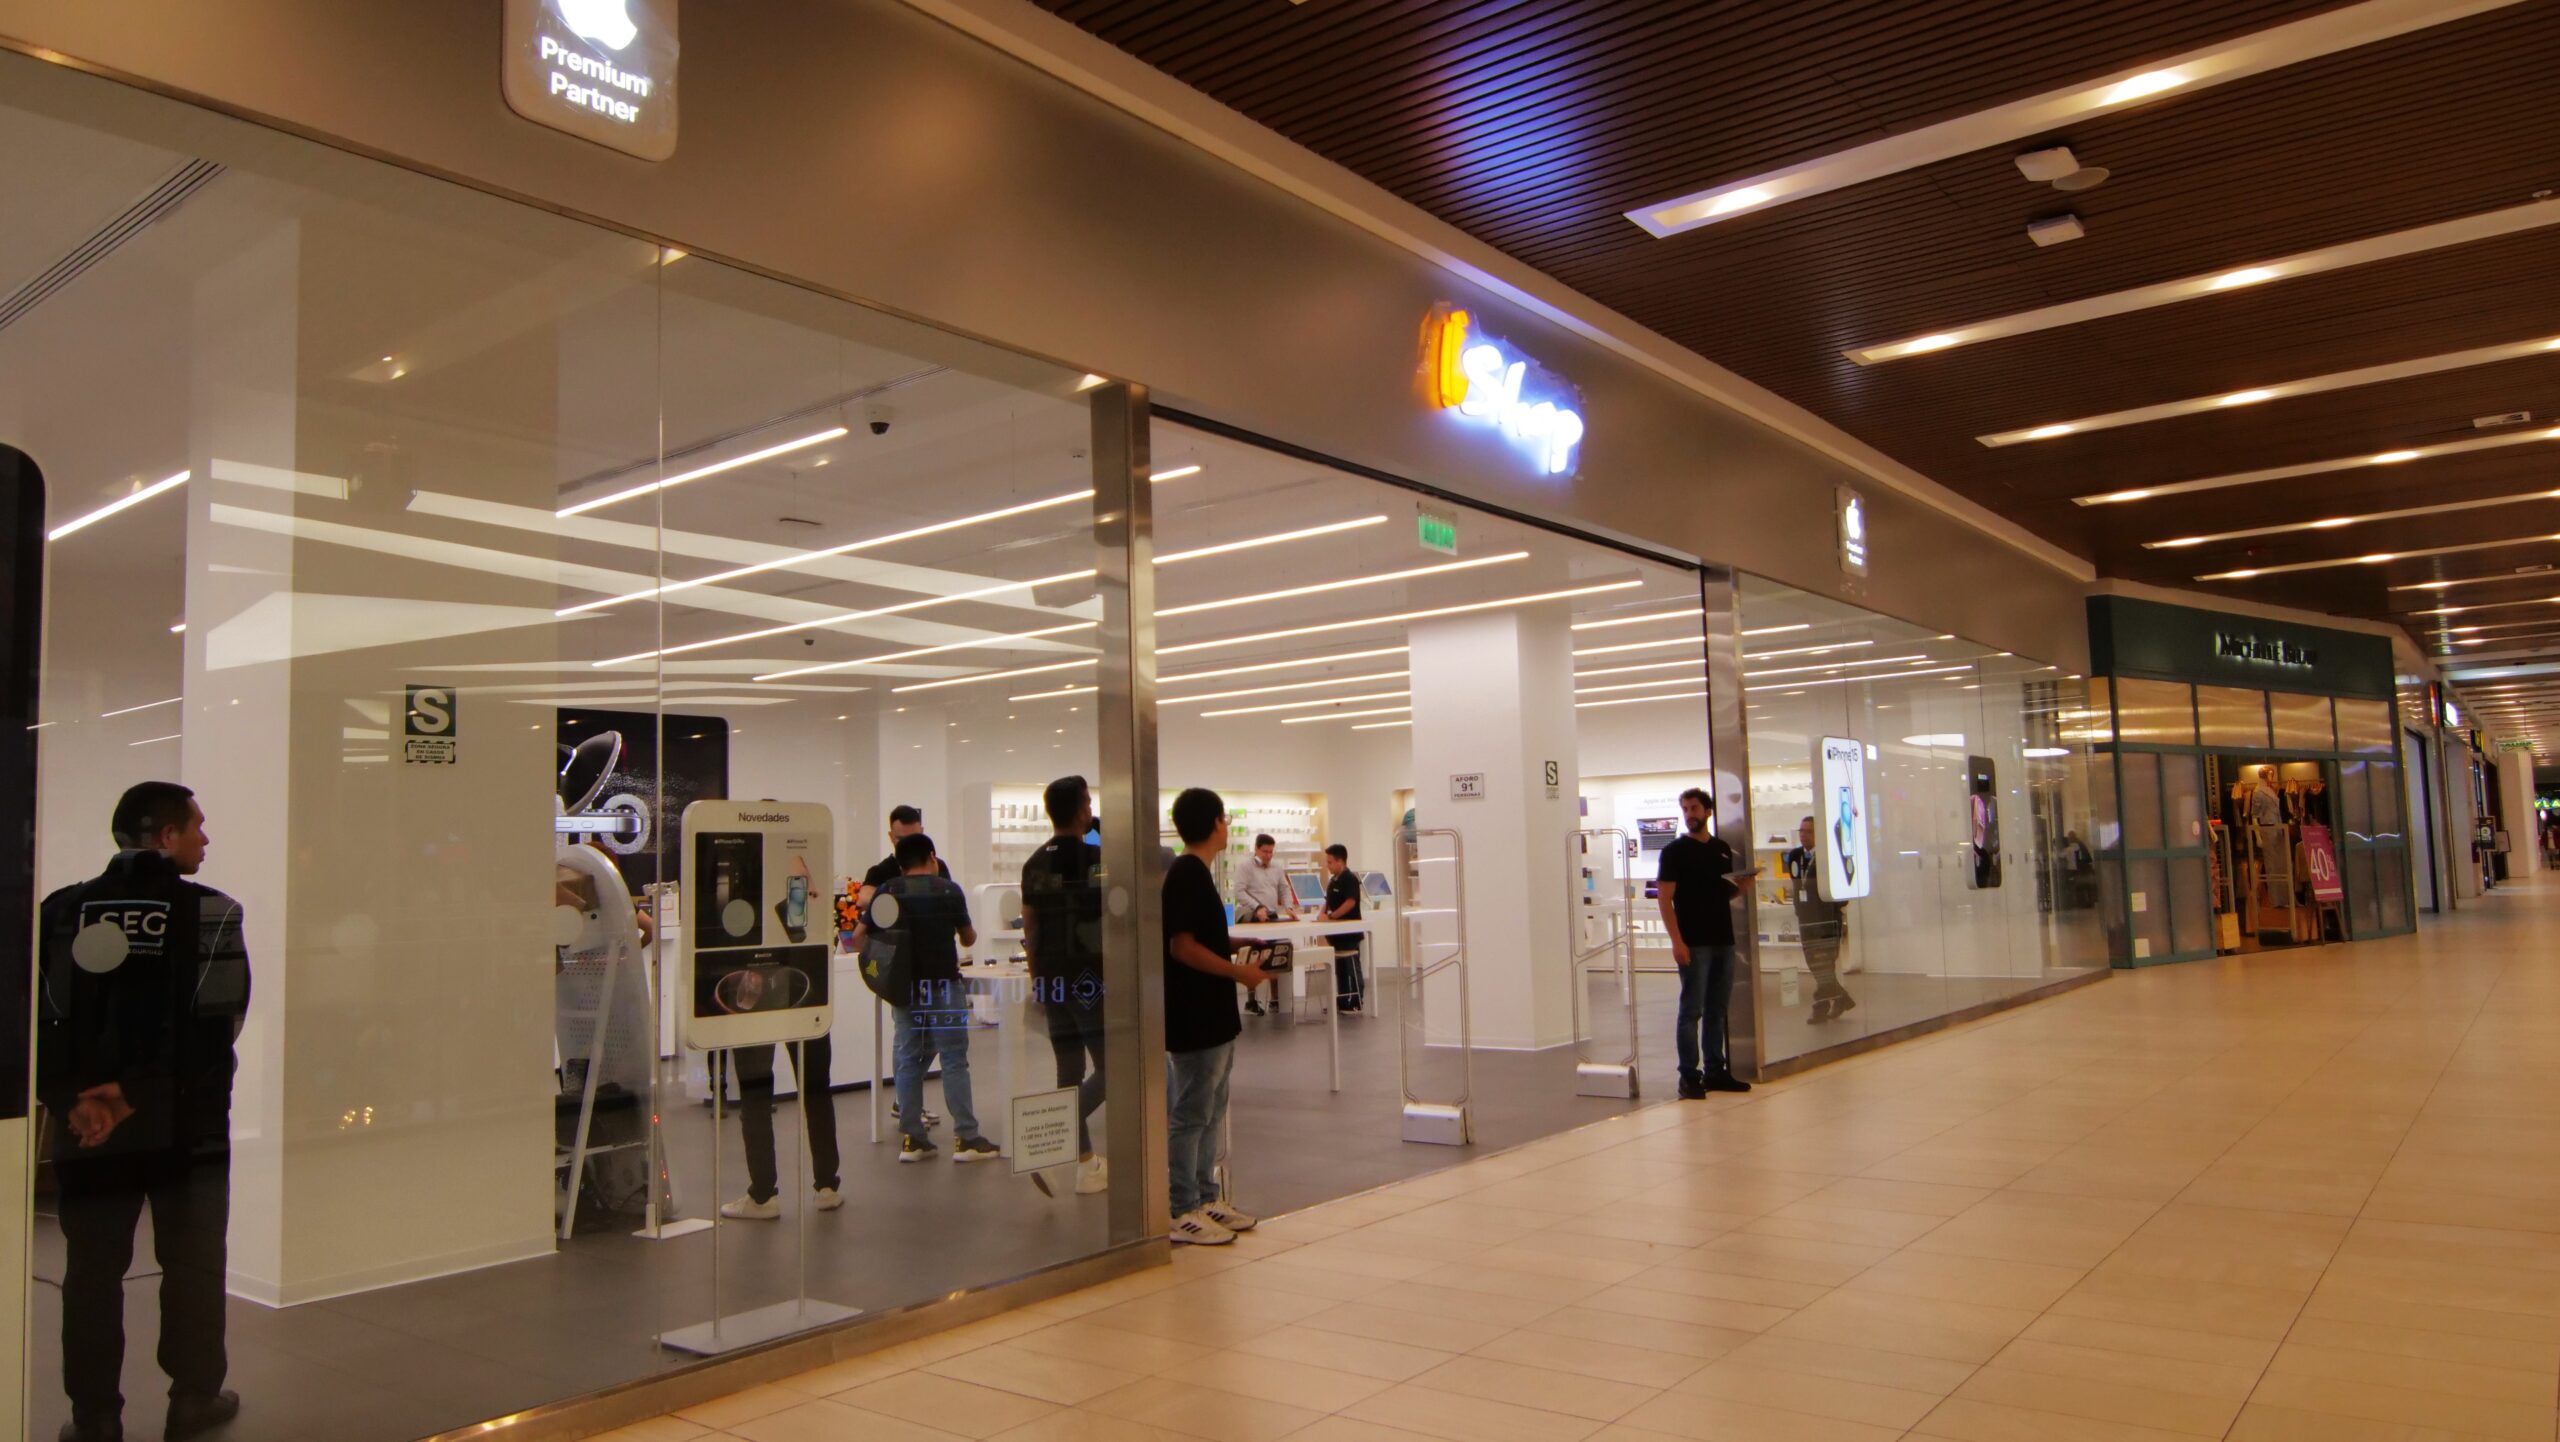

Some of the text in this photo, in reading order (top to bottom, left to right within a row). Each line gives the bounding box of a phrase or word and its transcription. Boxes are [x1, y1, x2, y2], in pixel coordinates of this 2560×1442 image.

[540, 35, 652, 97] Premium
[550, 71, 639, 123] Partner
[1437, 309, 1583, 476] iShop
[412, 688, 450, 733] S
[1462, 782, 1474, 792] 91
[738, 812, 790, 823] Novedades
